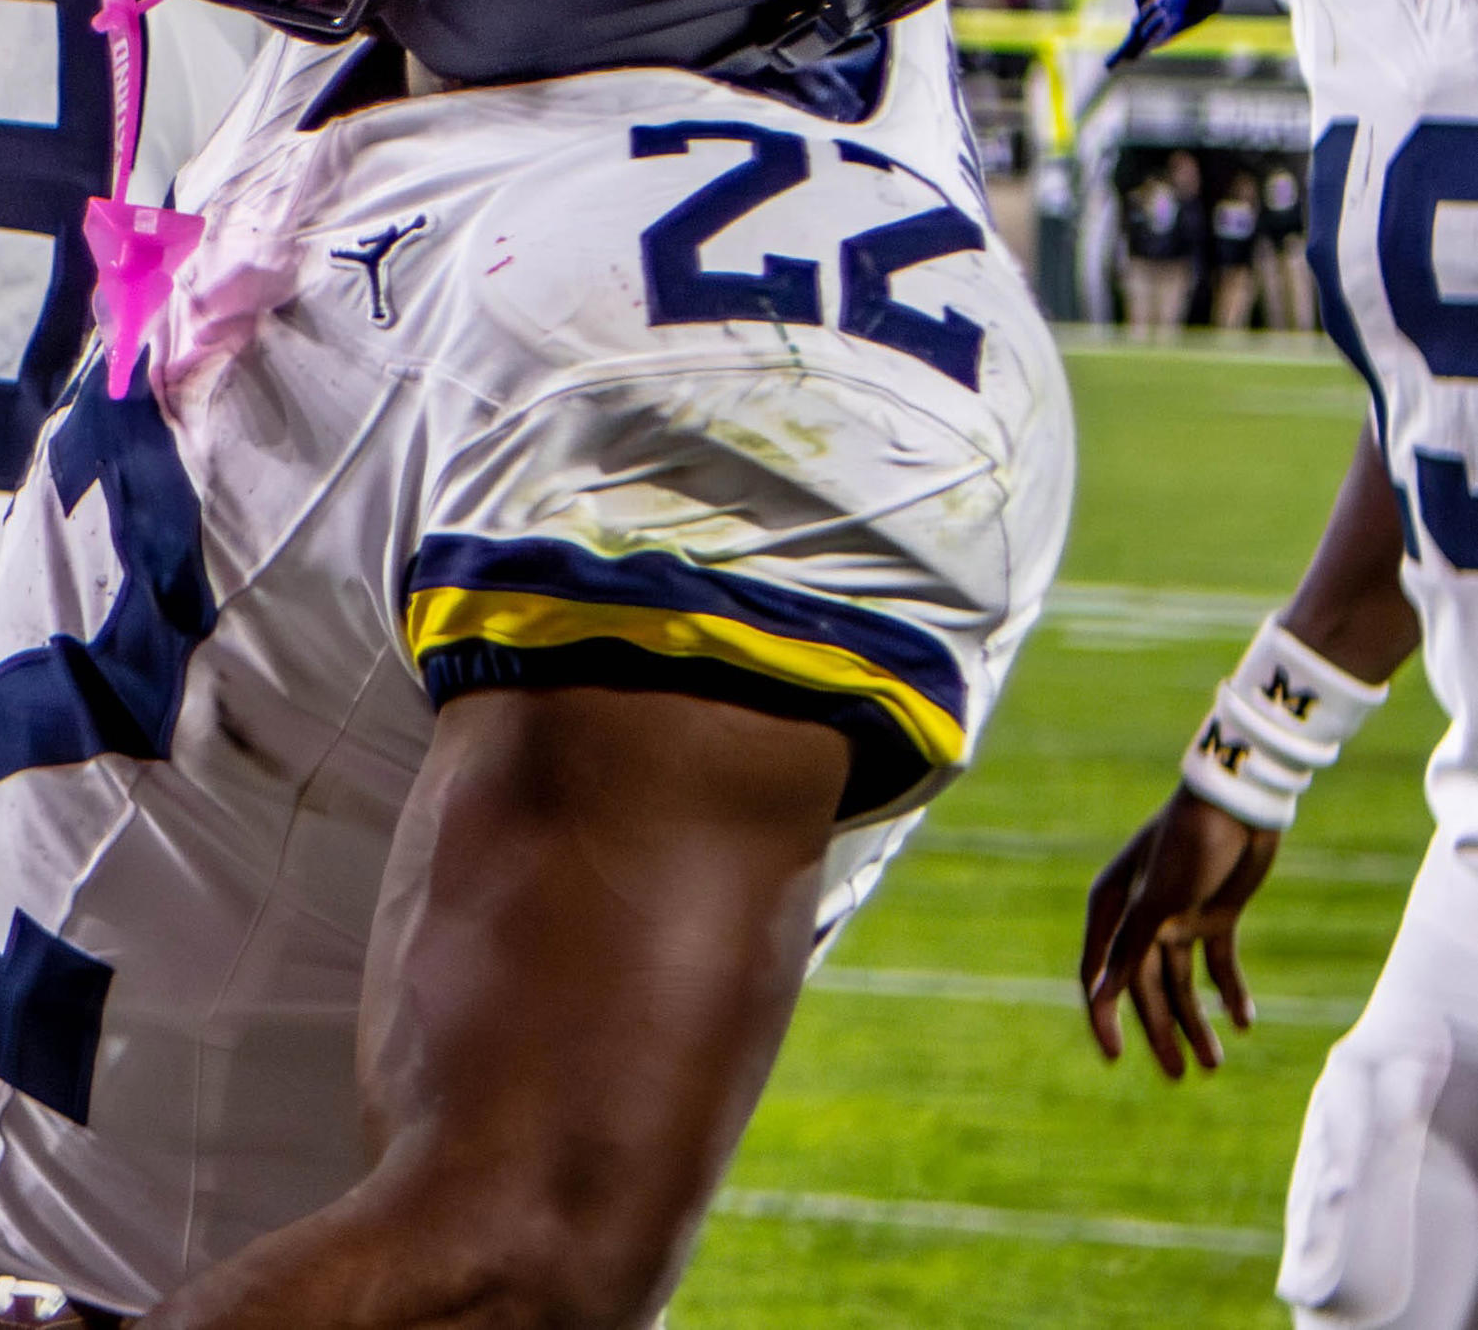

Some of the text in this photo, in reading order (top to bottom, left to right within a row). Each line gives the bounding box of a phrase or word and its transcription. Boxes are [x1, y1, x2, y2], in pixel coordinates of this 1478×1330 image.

[631, 119, 987, 392] 22
[1261, 665, 1318, 722] M
[1199, 718, 1250, 776] M
